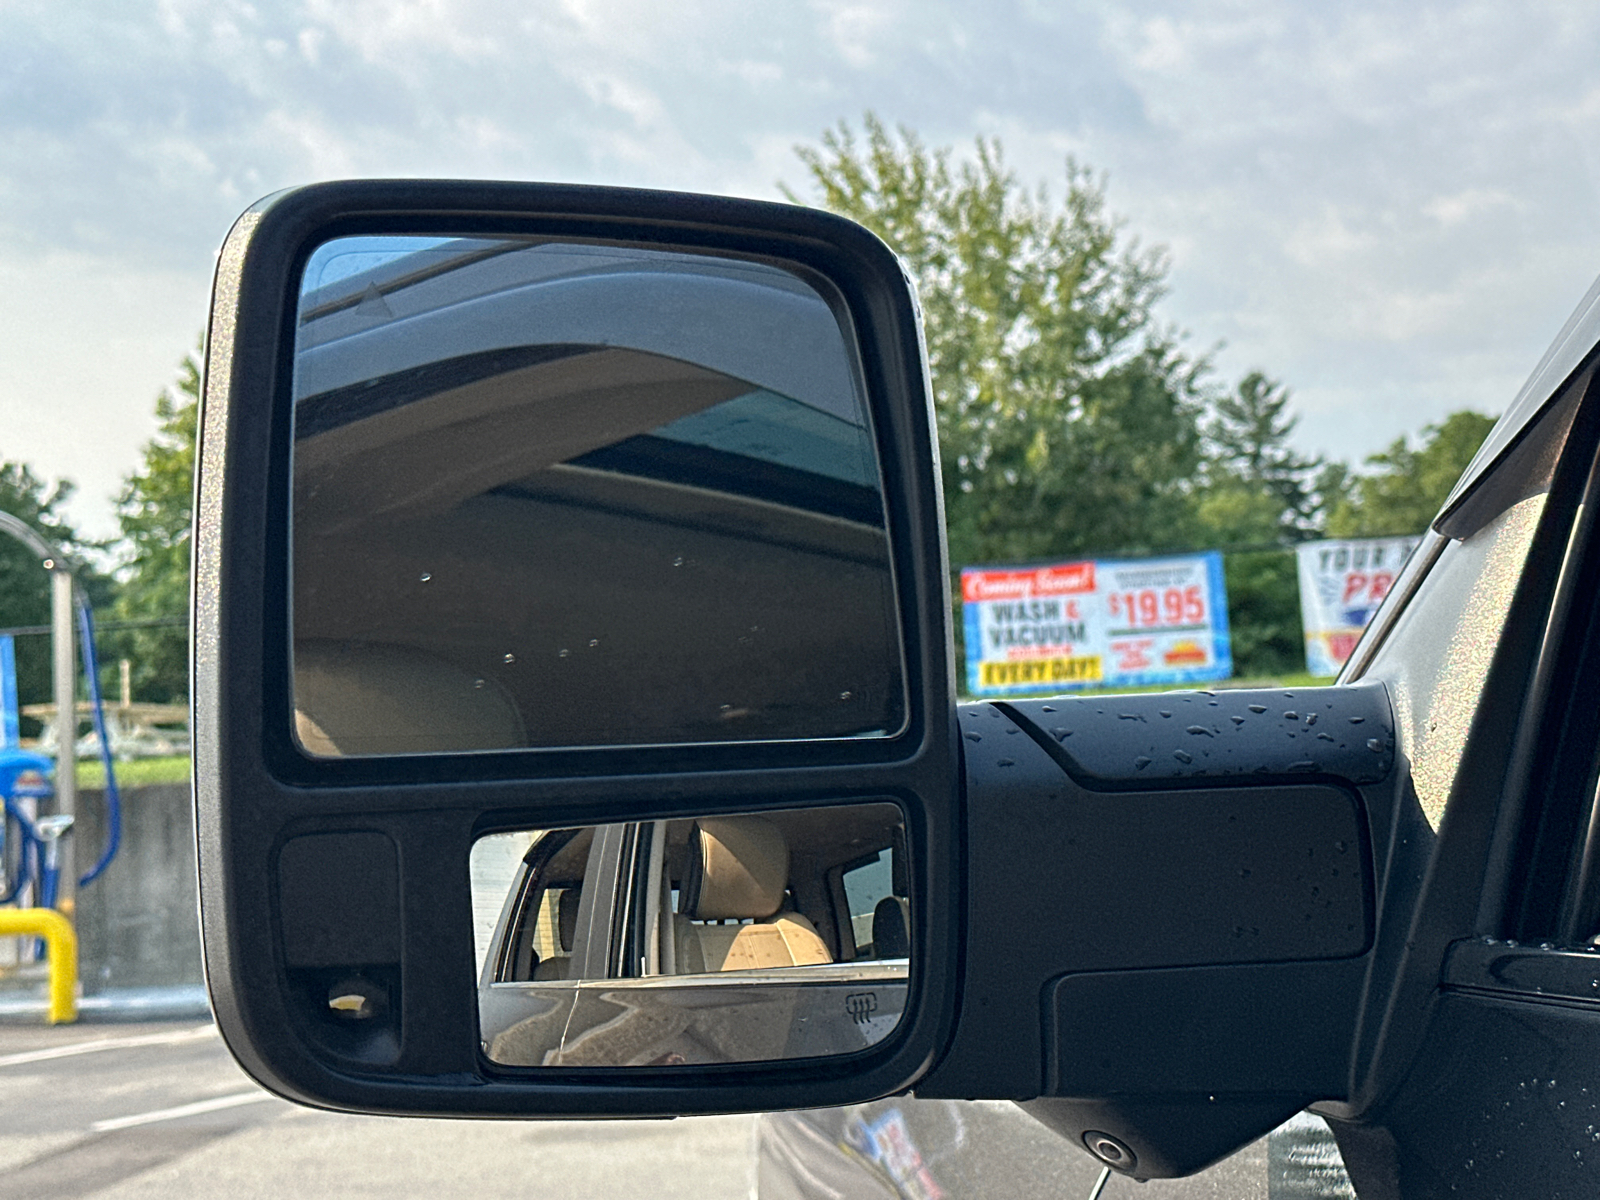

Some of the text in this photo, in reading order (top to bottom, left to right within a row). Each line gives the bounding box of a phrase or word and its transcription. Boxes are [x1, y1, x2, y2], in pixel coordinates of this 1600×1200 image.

[991, 600, 1060, 623] WASH
[987, 622, 1086, 646] VACUUM
[983, 660, 1048, 684] EVERY
